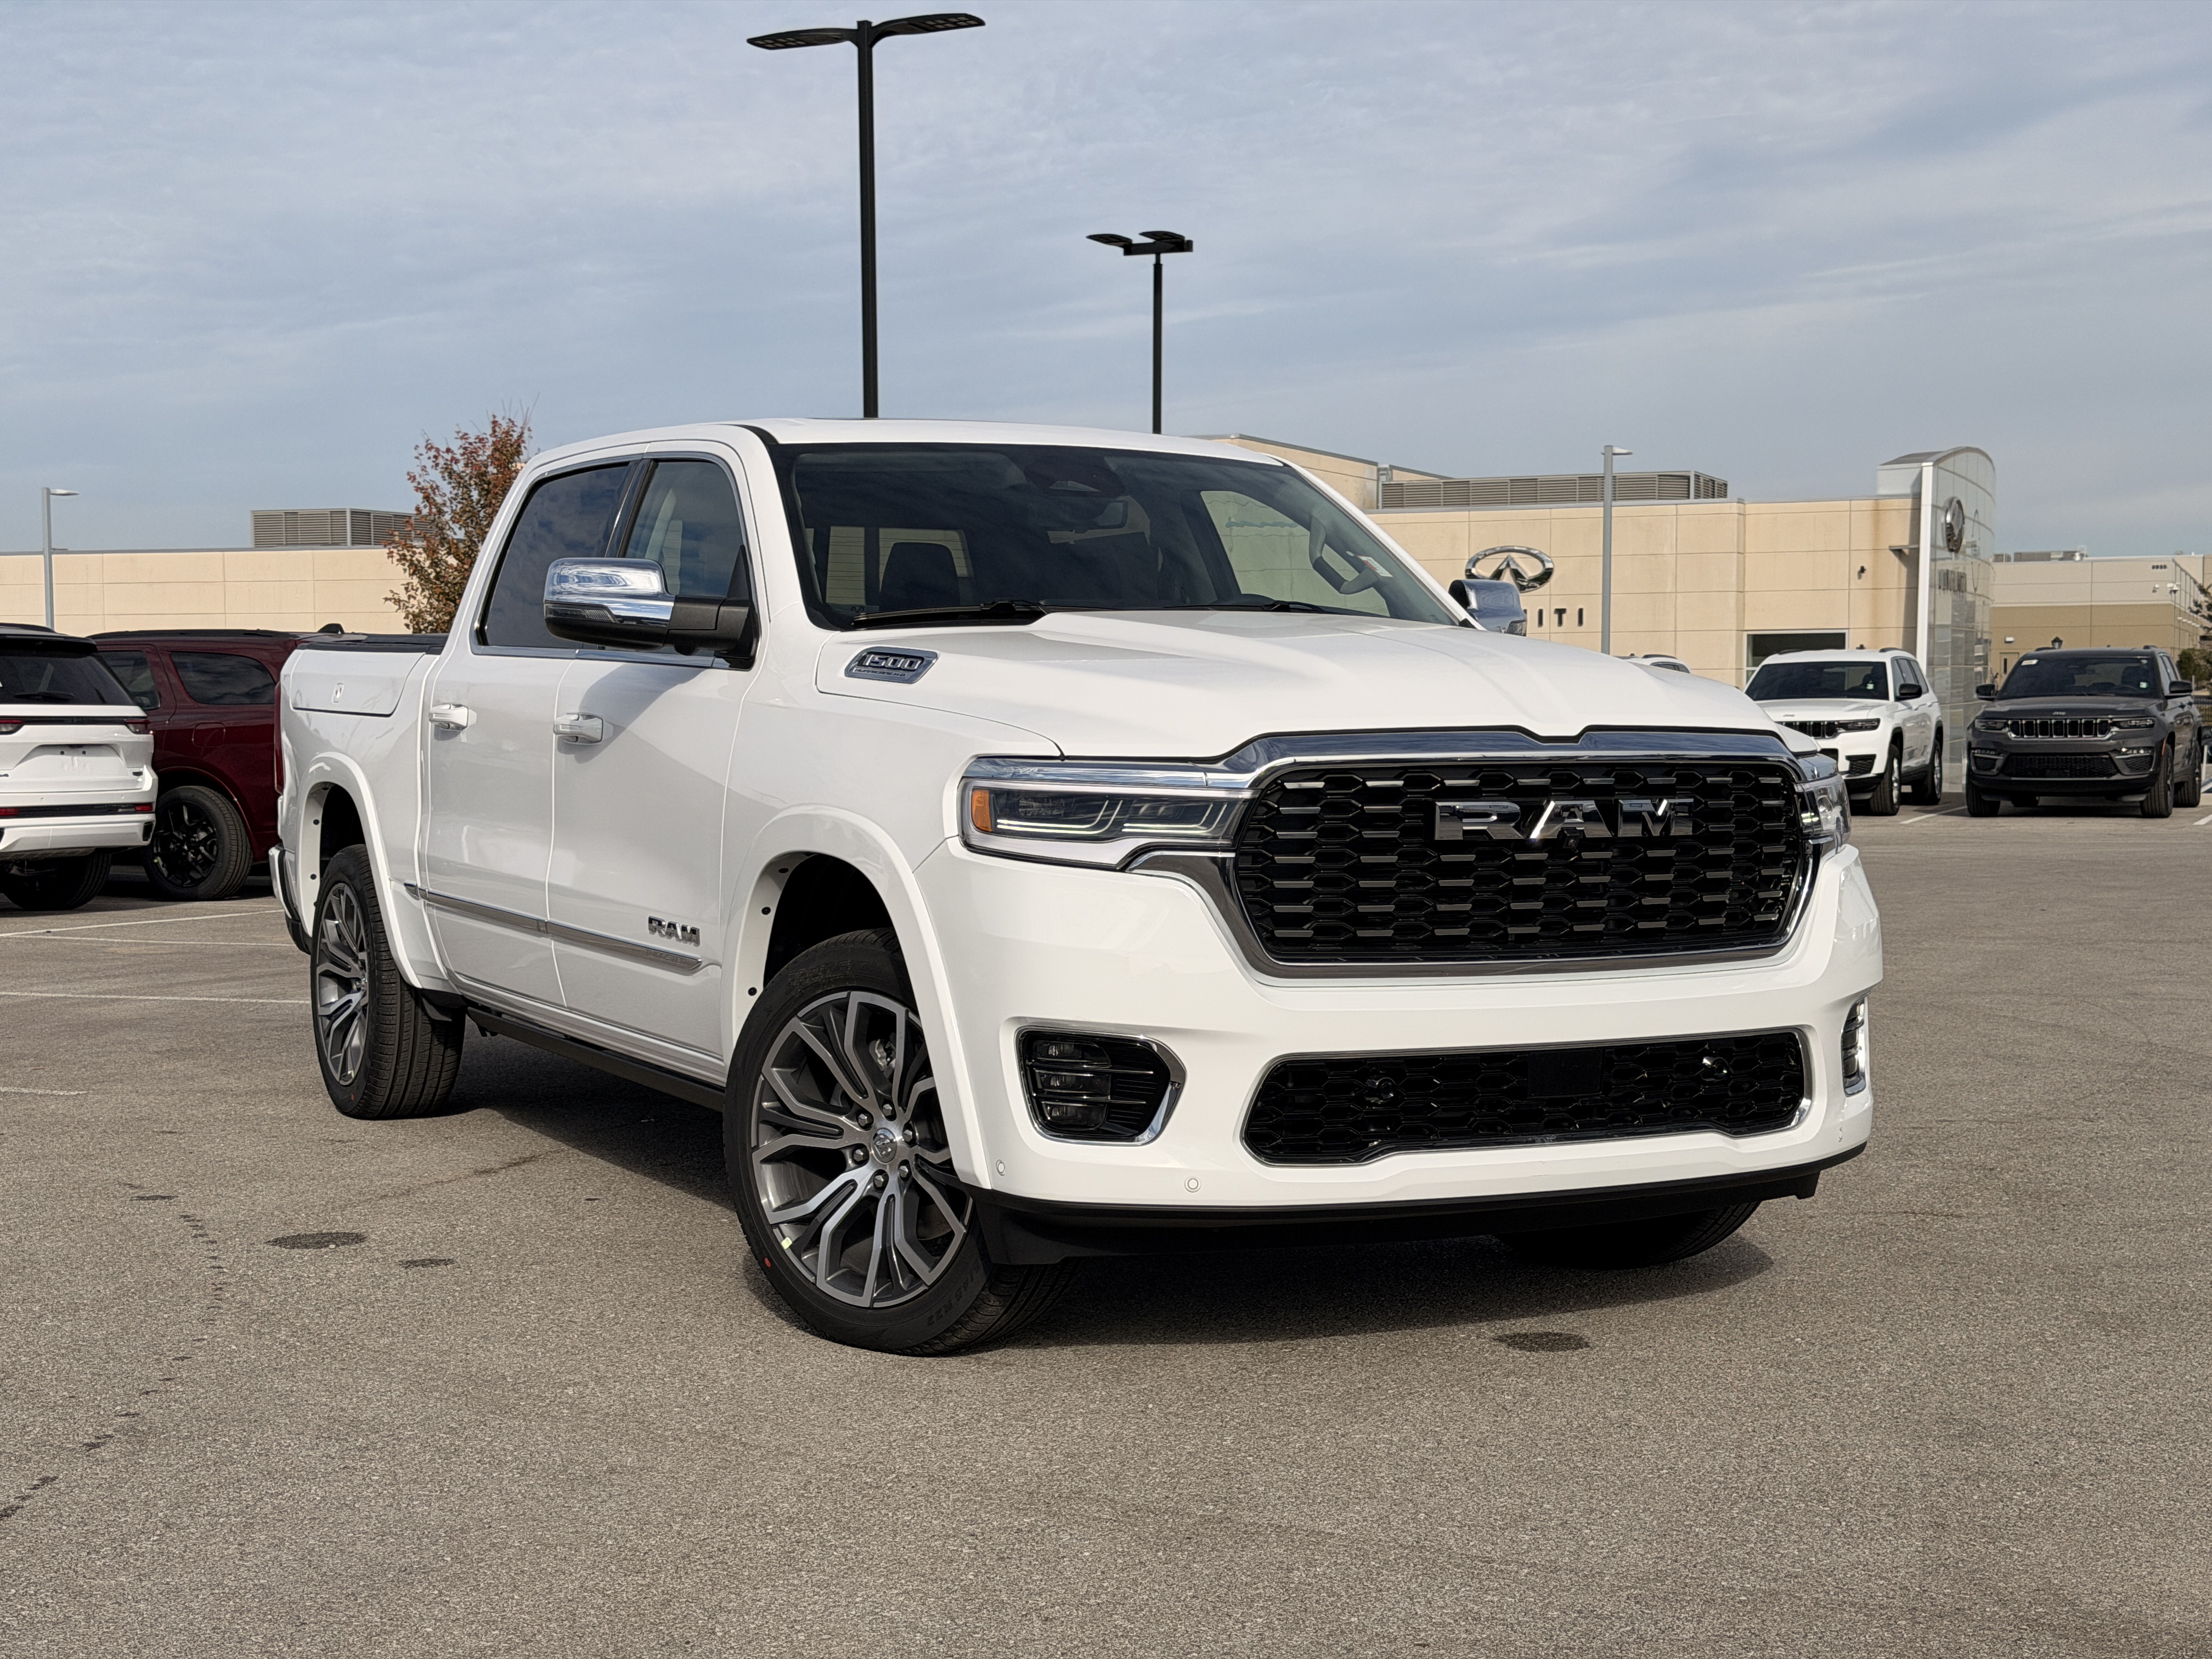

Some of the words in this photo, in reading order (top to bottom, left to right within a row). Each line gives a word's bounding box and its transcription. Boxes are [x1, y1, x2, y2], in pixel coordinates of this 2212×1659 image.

[862, 654, 922, 670] 1500
[1435, 799, 1694, 840] RAM
[648, 916, 700, 946] RAM
